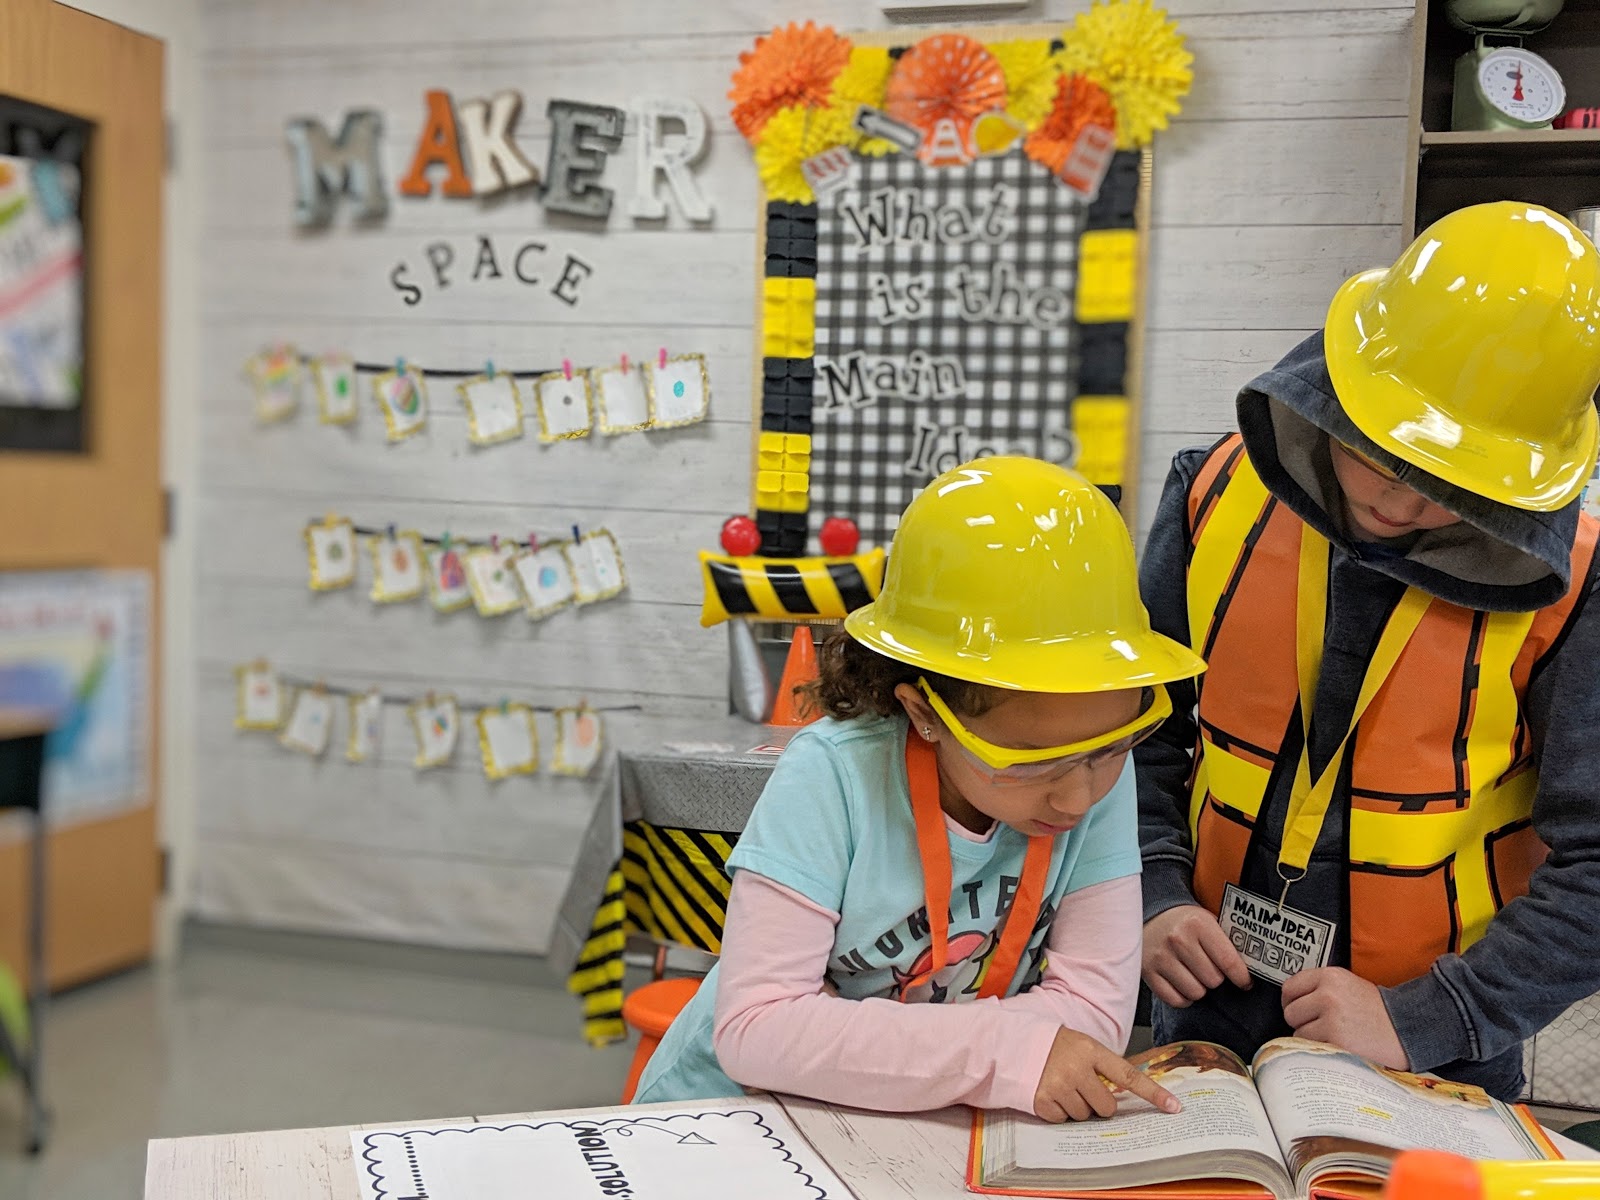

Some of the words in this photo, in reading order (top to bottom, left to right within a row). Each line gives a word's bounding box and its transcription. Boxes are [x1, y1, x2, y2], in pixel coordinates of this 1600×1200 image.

[286, 89, 713, 228] MAKER
[843, 187, 1006, 248] What
[389, 234, 593, 307] SPACE
[874, 276, 928, 320] is
[950, 268, 1064, 324] the
[820, 353, 963, 408] Main
[1230, 912, 1312, 956] CONSTRUCTION
[1233, 896, 1275, 926] MAIN
[1281, 917, 1316, 945] IDEA
[571, 1126, 635, 1196] SOLUTION
